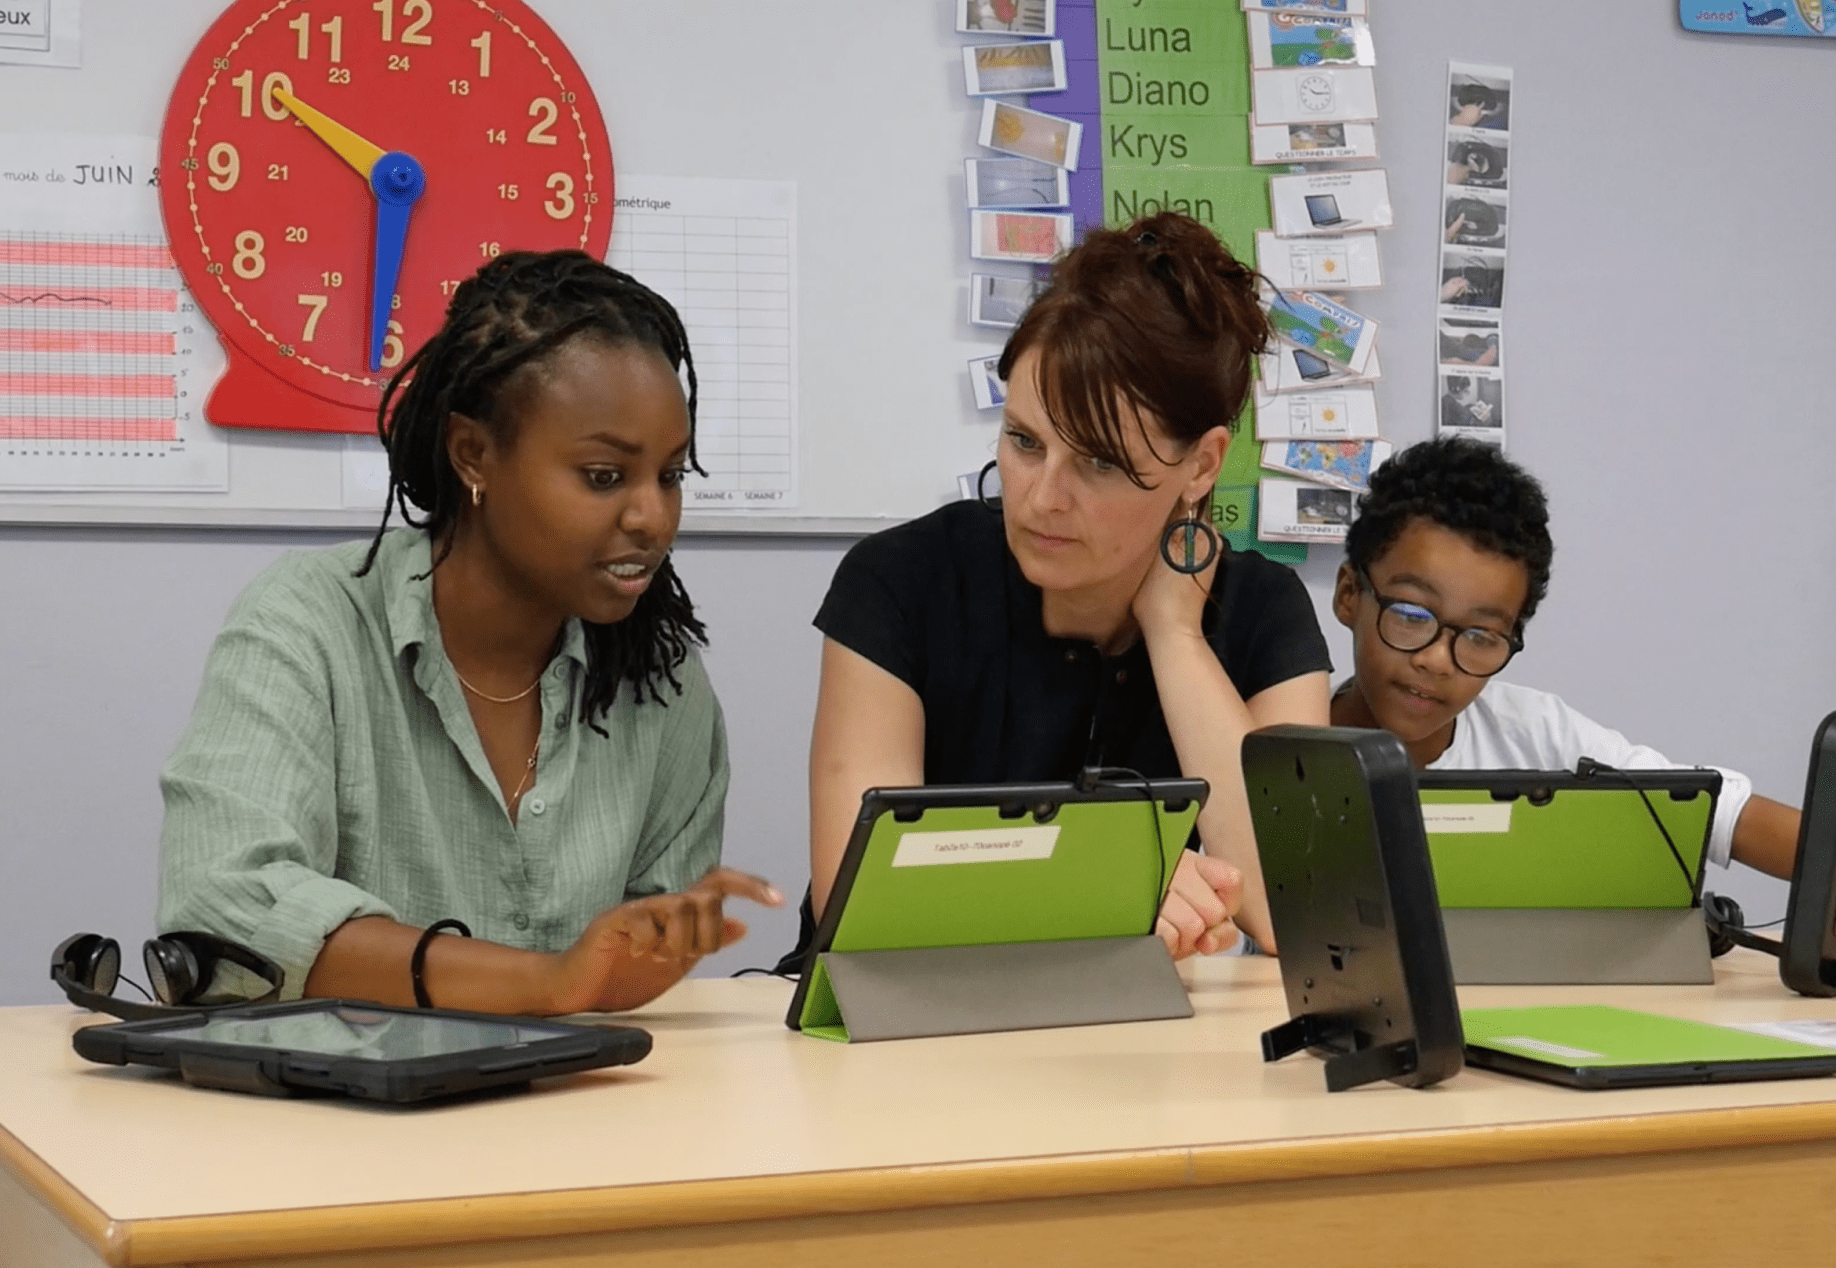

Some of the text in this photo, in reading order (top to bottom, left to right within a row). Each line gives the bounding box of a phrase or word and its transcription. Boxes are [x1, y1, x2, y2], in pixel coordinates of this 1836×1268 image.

[372, 0, 433, 45] 12
[288, 12, 343, 63] 11
[1106, 18, 1192, 52] Luna
[387, 54, 411, 71] 24
[470, 30, 492, 78] 1
[213, 57, 230, 71] 50
[328, 67, 351, 84] 23
[231, 69, 294, 121] 10
[448, 79, 470, 95] 13
[1108, 71, 1210, 106] Diano
[560, 91, 576, 103] 10
[526, 96, 558, 145] 2
[486, 128, 507, 145] 14
[1110, 124, 1188, 166] Krys
[182, 158, 199, 170] 45
[207, 141, 240, 192] 9
[267, 164, 289, 181] 21
[3, 169, 39, 183] mois
[73, 164, 133, 185] JUIN
[498, 183, 519, 200] 15
[544, 171, 575, 220] 3
[582, 191, 599, 204] 15
[1113, 190, 1214, 223] Nolan
[285, 226, 308, 243] 20
[232, 230, 265, 279] 8
[479, 241, 501, 258] 16
[206, 262, 223, 275] 40
[321, 271, 343, 288] 19
[440, 279, 461, 296] 17
[298, 294, 328, 342] 7
[279, 344, 296, 357] 35
[380, 320, 405, 368] 6
[694, 491, 726, 500] SEMAINE
[745, 491, 776, 501] SEMAINE
